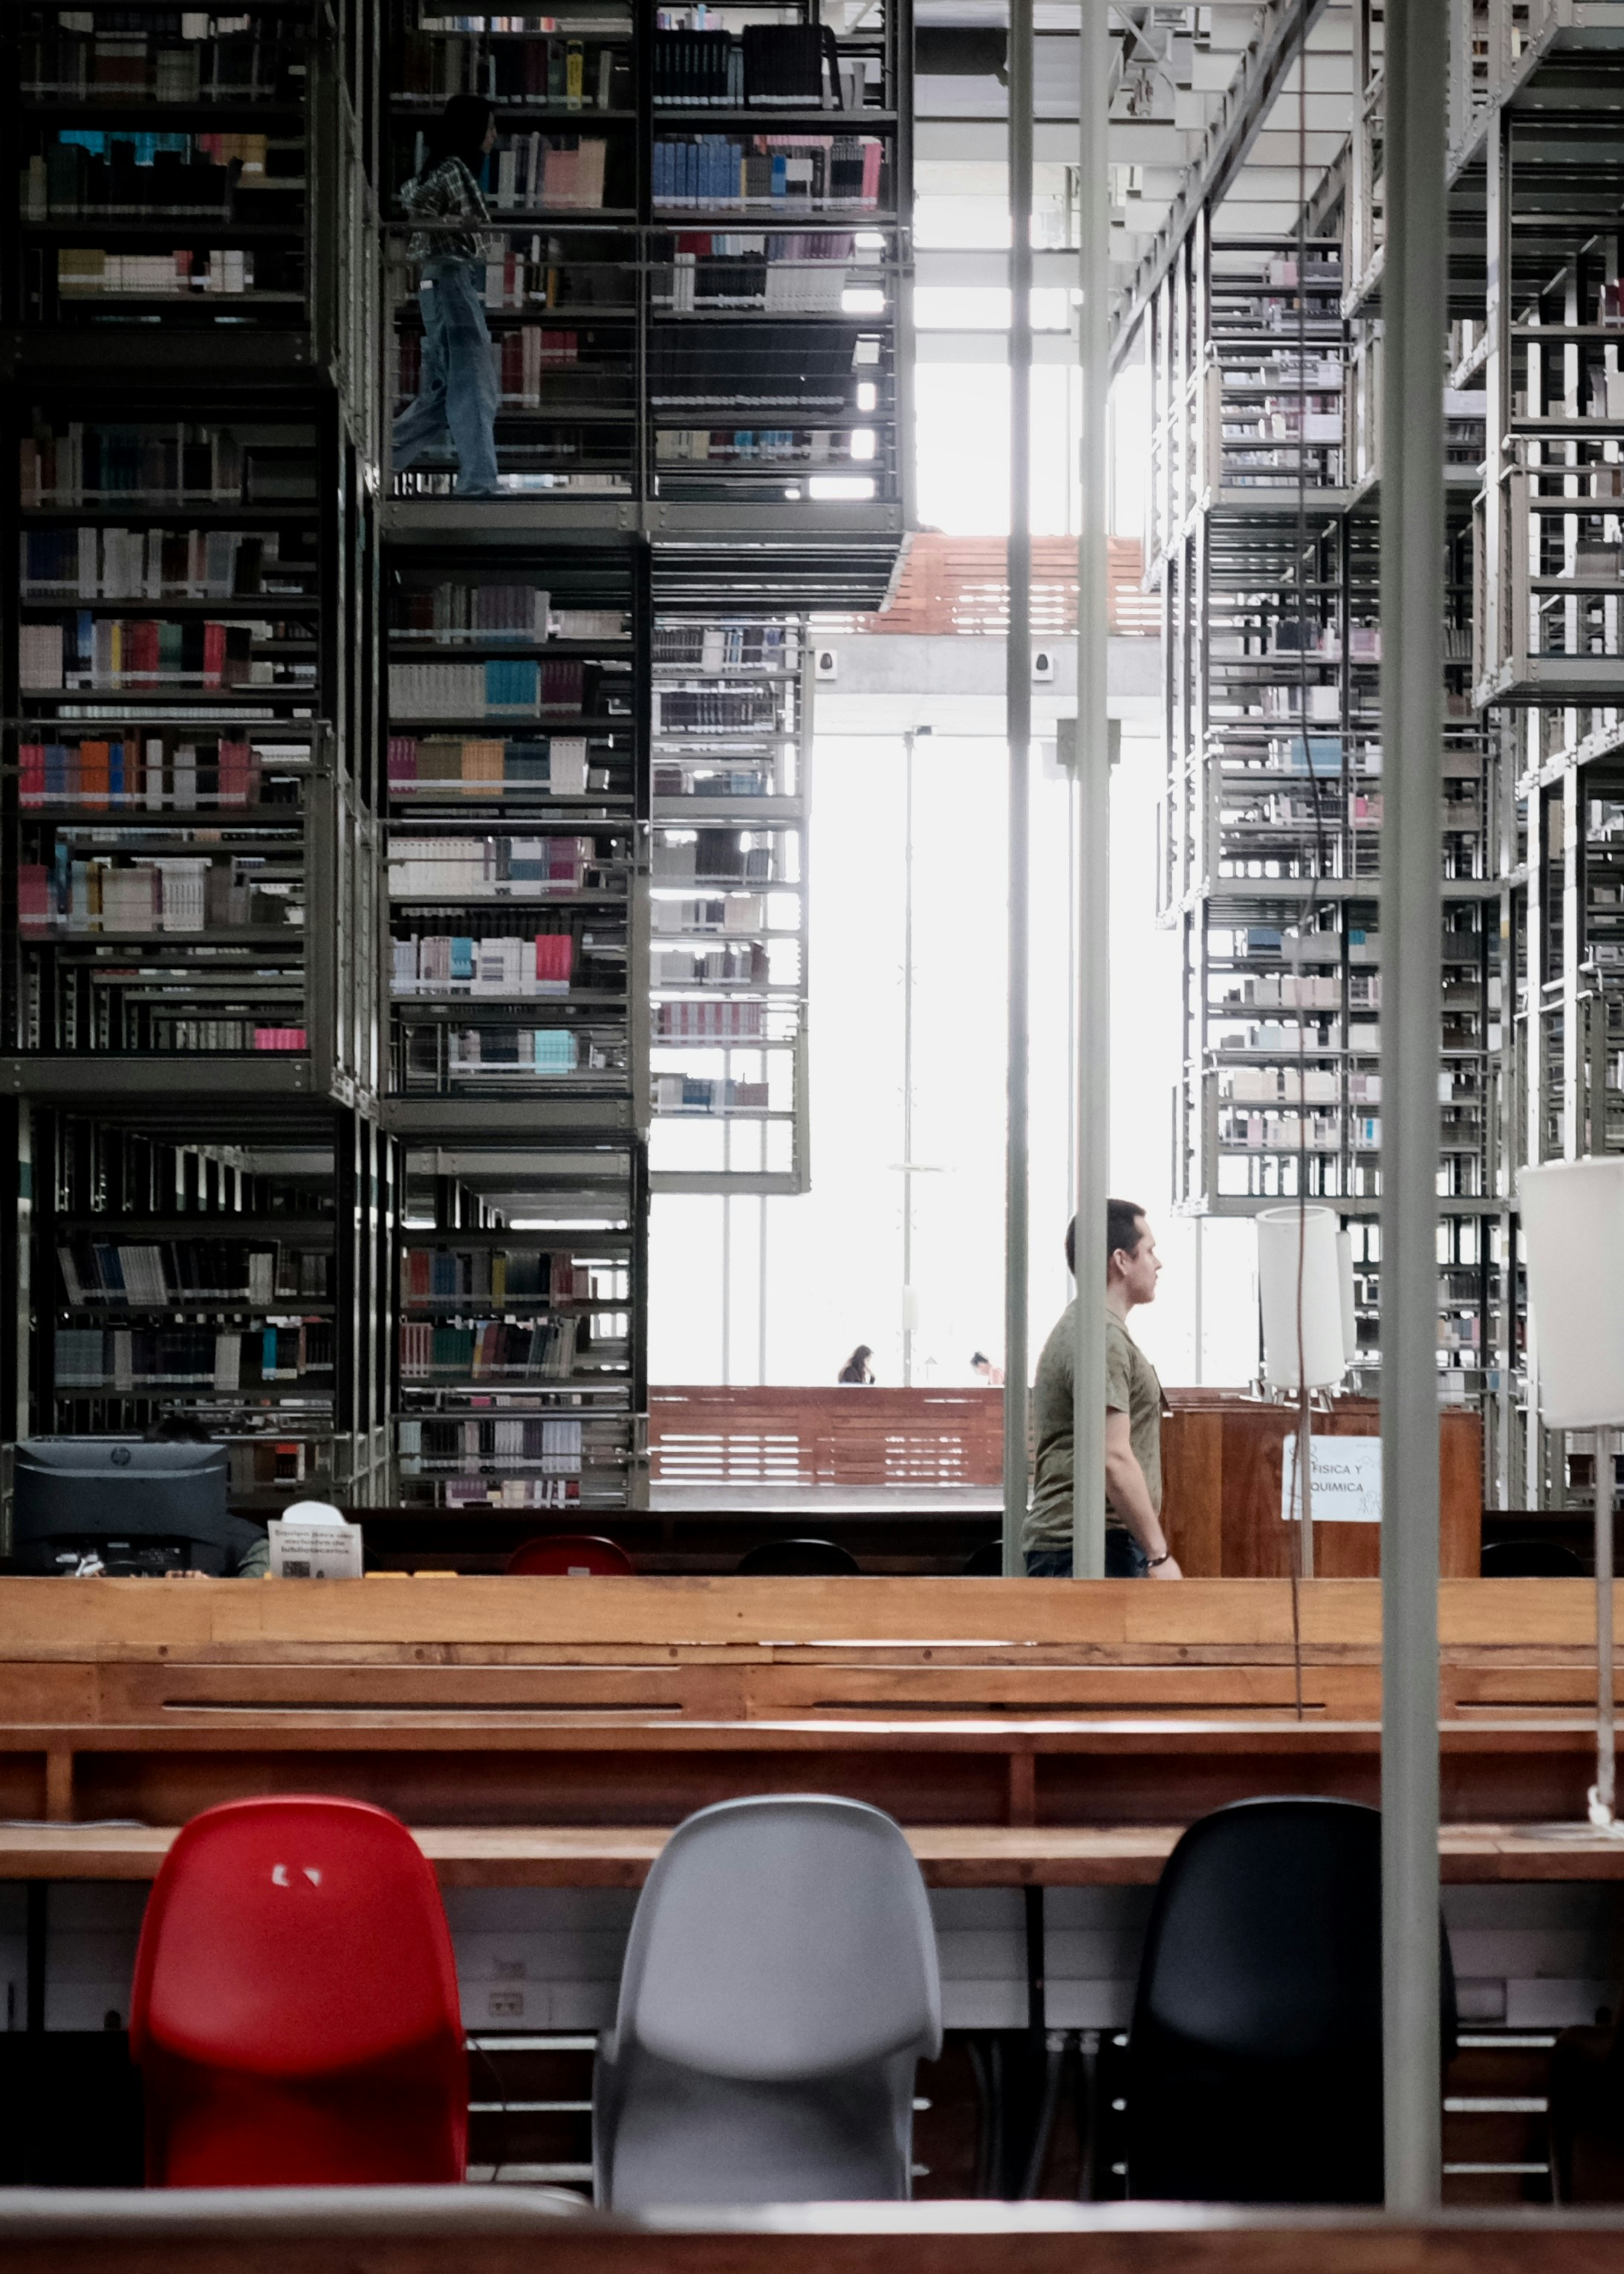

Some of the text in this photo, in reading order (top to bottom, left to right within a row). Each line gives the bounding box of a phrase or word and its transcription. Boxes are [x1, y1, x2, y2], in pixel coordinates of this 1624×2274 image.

[1312, 1464, 1362, 1474] FISICA Y
[1310, 1482, 1363, 1492] QUIMICA
